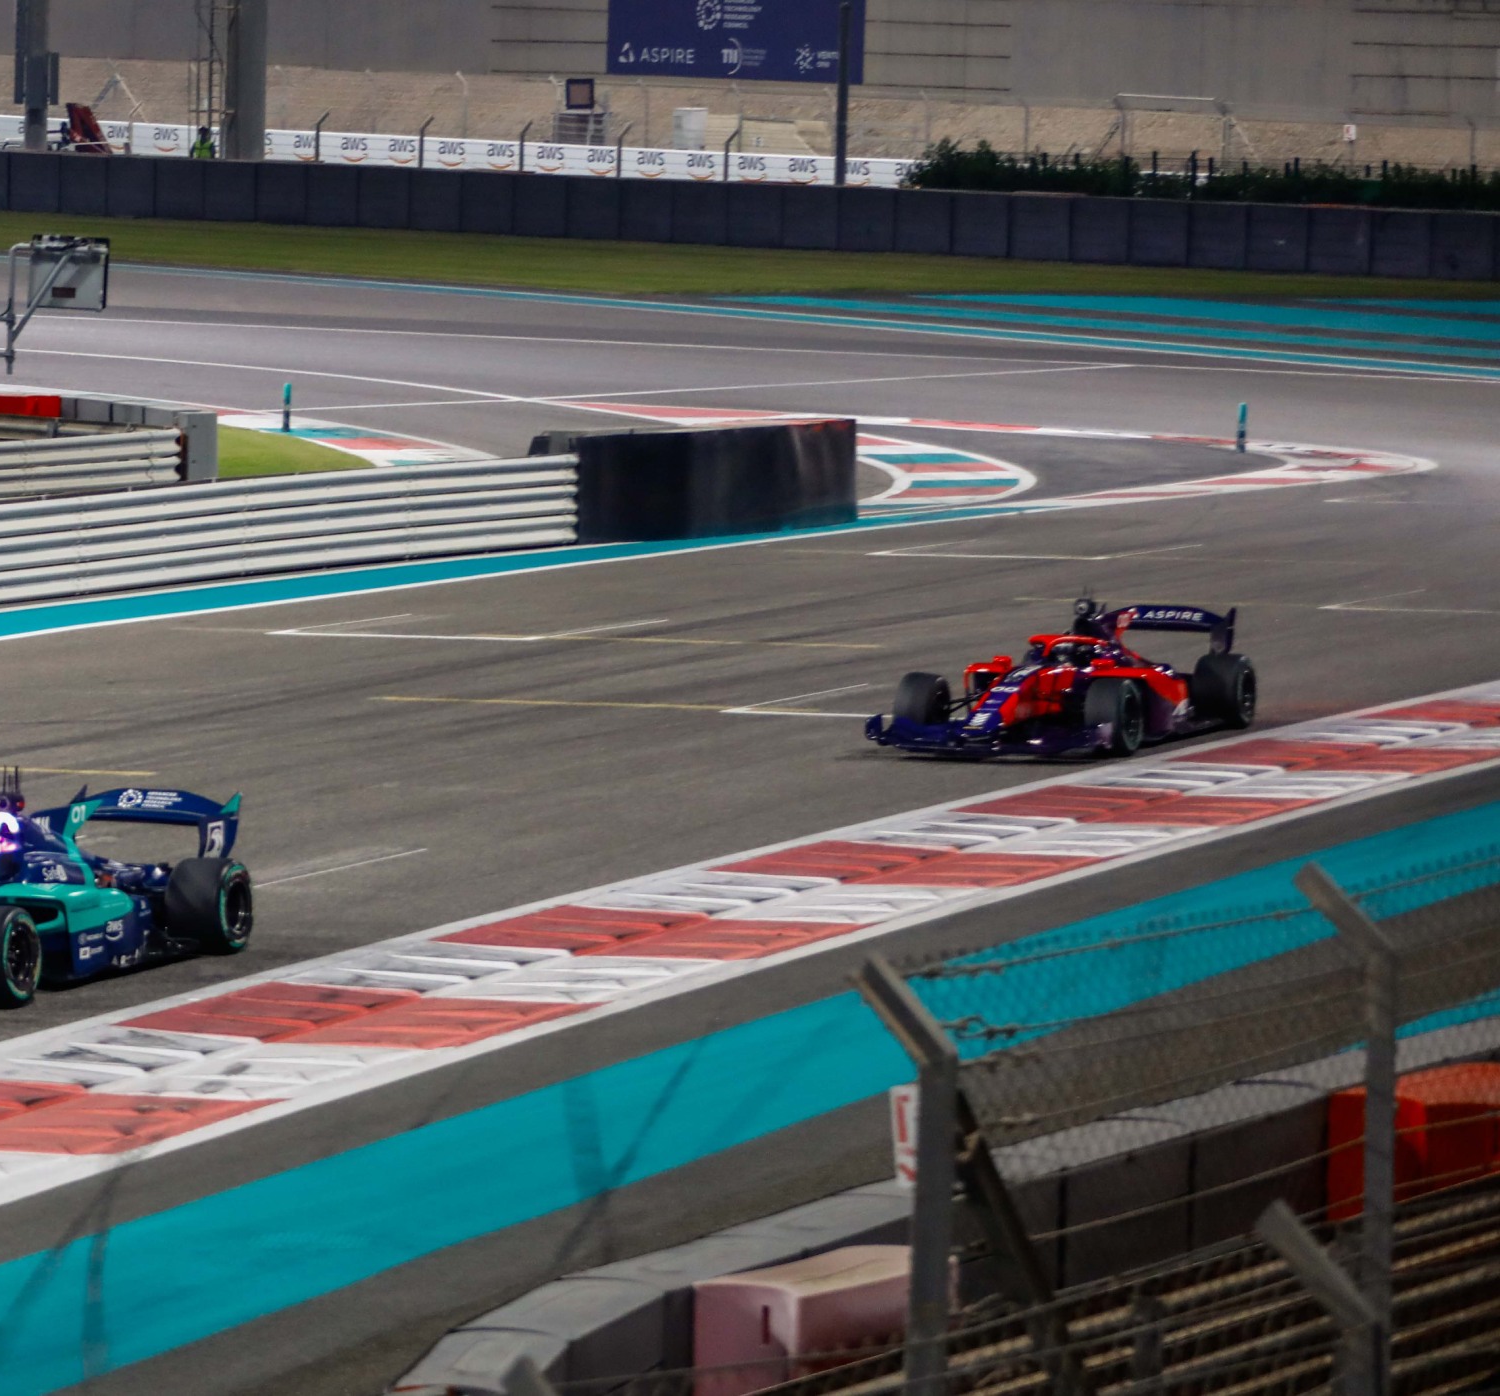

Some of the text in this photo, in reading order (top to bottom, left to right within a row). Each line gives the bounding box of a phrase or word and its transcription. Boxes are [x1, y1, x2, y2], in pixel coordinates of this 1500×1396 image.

[640, 48, 695, 64] ASPIRE
[154, 127, 179, 141] aws
[341, 137, 368, 151] aws
[388, 138, 416, 153] aws
[438, 141, 466, 156] aws
[487, 143, 515, 158] aws
[536, 146, 564, 160] aws
[587, 148, 615, 164] aws
[637, 151, 665, 166] aws
[686, 153, 715, 169] aws
[737, 156, 766, 171] aws
[788, 158, 818, 174] aws
[845, 161, 870, 176] ws
[1143, 611, 1204, 621] ASPIRE
[71, 805, 86, 823] 01
[106, 920, 123, 932] aws
